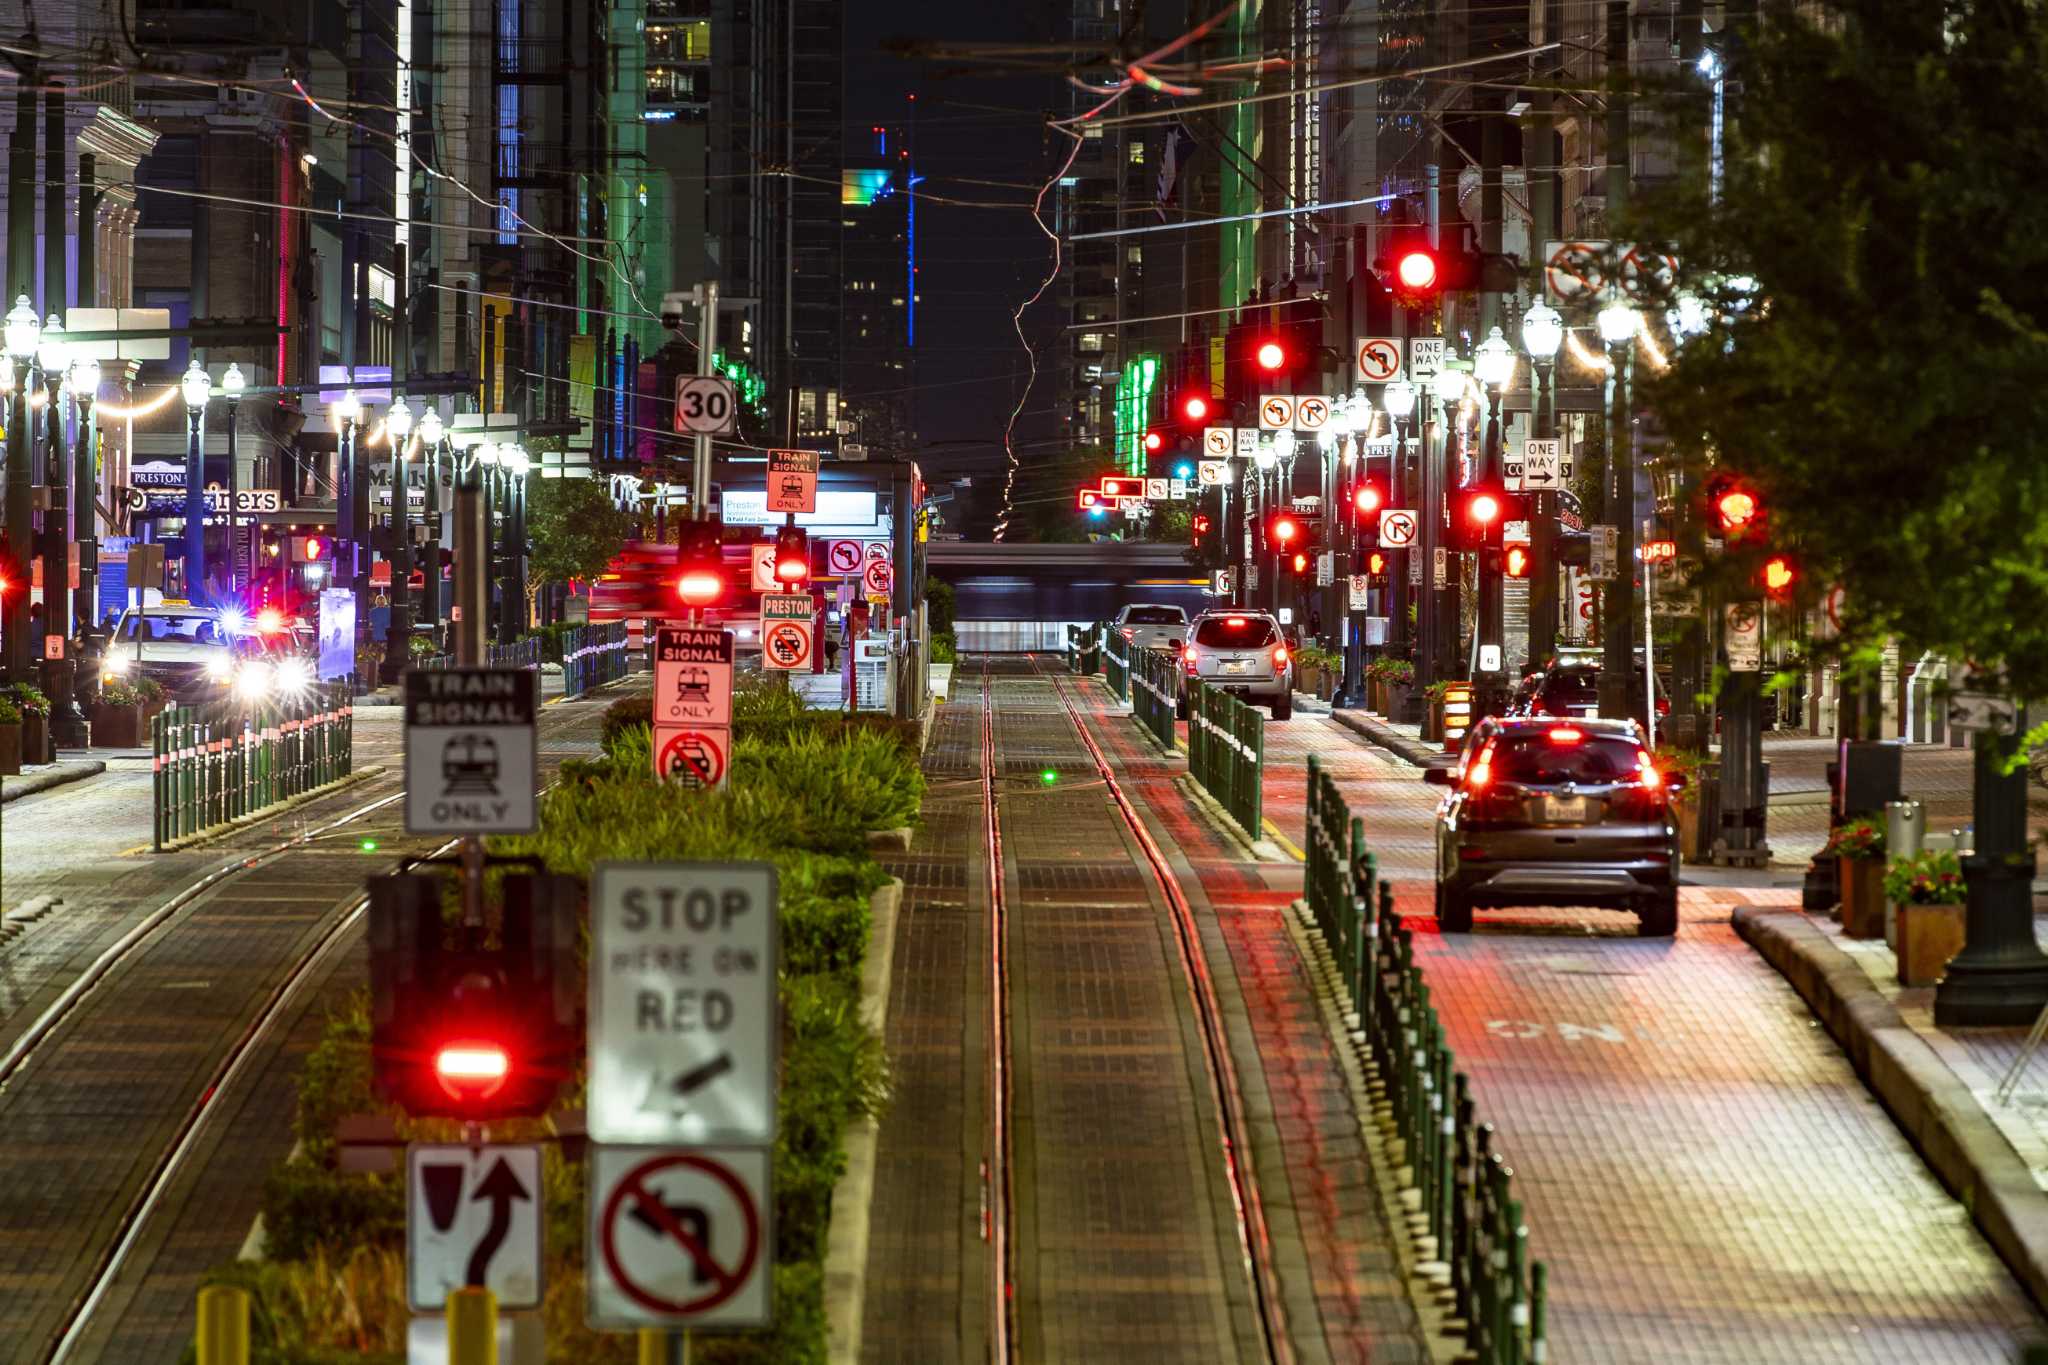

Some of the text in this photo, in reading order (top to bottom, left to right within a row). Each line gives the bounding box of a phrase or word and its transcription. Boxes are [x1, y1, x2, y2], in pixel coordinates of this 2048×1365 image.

[1415, 342, 1441, 353] ONE
[1415, 354, 1441, 365] WAY
[684, 391, 727, 419] 30
[1240, 438, 1256, 446] WAY
[1371, 445, 1416, 455] PREN
[1528, 443, 1555, 455] ONE
[777, 452, 811, 462] TRAIN
[1528, 456, 1555, 468] WAY
[773, 463, 813, 472] SIGNAL
[135, 473, 182, 483] PRESTON
[726, 500, 761, 509] Preston
[776, 500, 806, 509] ONLY
[765, 599, 811, 614] PRESTON
[670, 631, 721, 646] TRAIN
[663, 648, 726, 662] SIGNAL
[426, 674, 515, 695] TRAIN
[415, 703, 524, 724] SIGNAL
[670, 706, 715, 718] ONLY
[430, 802, 510, 823] ONLY
[620, 886, 752, 933] STOP
[610, 944, 759, 977] HERE ON
[635, 988, 735, 1034] RED
